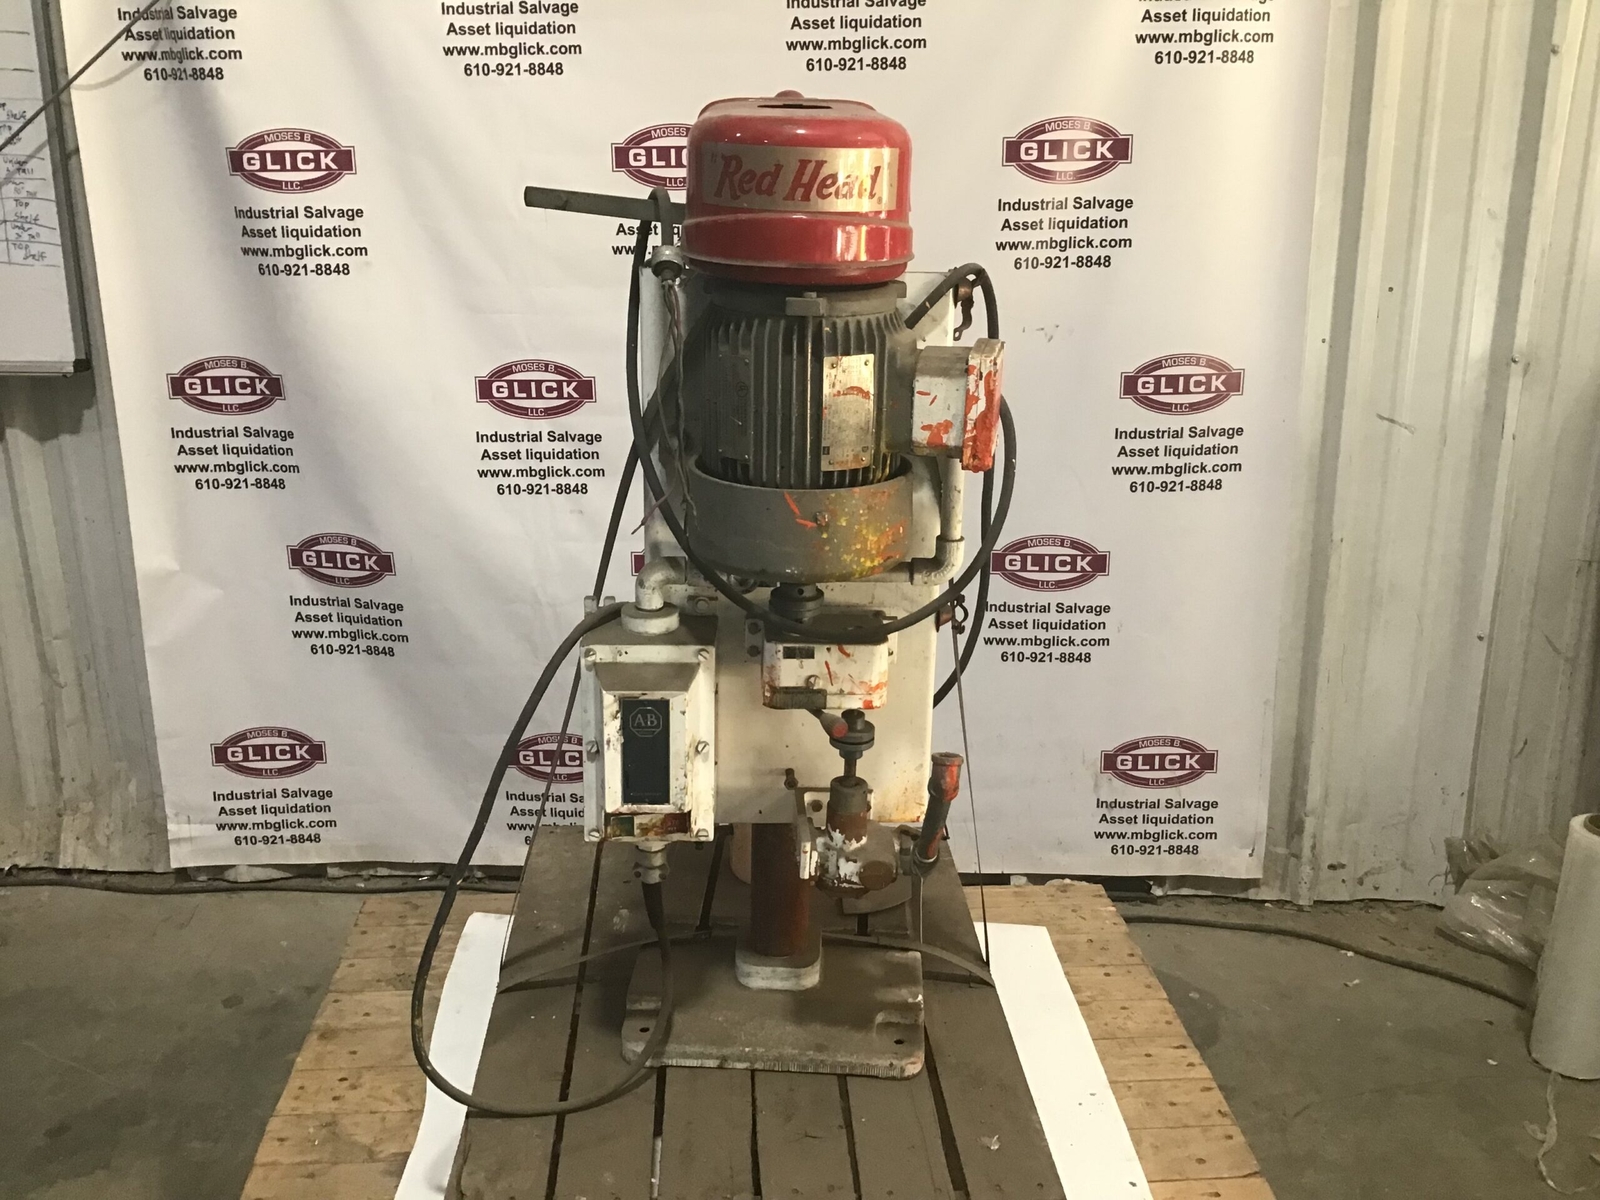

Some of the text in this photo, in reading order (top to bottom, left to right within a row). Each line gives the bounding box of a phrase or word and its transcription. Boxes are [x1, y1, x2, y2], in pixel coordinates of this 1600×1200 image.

[117, 6, 238, 22] Industrial Salvage
[441, 1, 579, 16] Industrial Salvage
[790, 14, 923, 32] Asset liquidation
[1141, 8, 1271, 25] Asset liquidation
[124, 27, 235, 43] Asset liquidation
[446, 21, 576, 39] Asset liquidation
[786, 36, 927, 53] www.mbglick.com
[1135, 29, 1274, 46] www.mbglick.com
[121, 47, 243, 64] www.mbglick.com
[442, 42, 582, 59] www.mbglick.com
[1154, 50, 1255, 65] 610-921-8848
[464, 63, 564, 77] 610-921-8848
[806, 56, 907, 72] 610-921-8848
[143, 67, 224, 81] 610-921-8848
[651, 127, 687, 139] MOSES
[1045, 120, 1081, 132] MOSES
[264, 132, 301, 143] MOSES
[1020, 140, 1115, 160] GLICK
[242, 151, 339, 171] GLICK
[628, 148, 688, 167] GLI
[783, 159, 882, 202] Head
[997, 196, 1134, 213] Industrial Salvage
[234, 206, 365, 222] Industrial Salvage
[615, 223, 659, 236] Ast
[1000, 216, 1128, 233] Asset liquidation
[241, 225, 362, 241] Asset liquidation
[995, 236, 1133, 252] www.mbglick.com
[240, 245, 368, 260] www.mbglick.com
[1013, 255, 1112, 270] 610-921-8848
[257, 263, 351, 277] 610-921-8848
[204, 360, 238, 370] MOSES
[512, 363, 545, 373] MOSES
[1162, 357, 1197, 368] MOSES
[184, 378, 271, 395] GLICK
[491, 382, 580, 398] GLICK
[1137, 375, 1227, 394] GLICK
[171, 426, 294, 441] Industrial Salvage
[476, 431, 603, 445] Industrial Salvage
[1114, 426, 1244, 441] Industrial Salvage
[177, 444, 294, 457] Asset liquidation
[481, 449, 600, 462] Asset liquidation
[1117, 443, 1239, 459] Asset liquidation
[174, 461, 300, 475] www.mbglick.com
[477, 466, 605, 480] www.mbglick.com
[1111, 462, 1242, 478] www.mbglick.com
[195, 478, 286, 490] 610-921-8848
[497, 483, 589, 496] 610-921-8848
[1129, 479, 1223, 493] 610-921-8848
[319, 536, 349, 545] MOSES
[1027, 538, 1061, 547] MOSES
[302, 550, 380, 571] GLICK
[1004, 554, 1093, 572] GLICK
[289, 595, 404, 614] Industrial Salvage
[985, 601, 1111, 615] Industrial Salvage
[294, 612, 403, 628] Asset liquidation
[988, 618, 1107, 632] Asset liquidation
[291, 629, 409, 643] www.mbglick.com
[983, 636, 1110, 649] www.mbglick.com
[310, 644, 395, 658] 610-921-8848
[1000, 651, 1092, 663] 610-921-8848
[247, 729, 279, 739] MOSES
[538, 736, 568, 744] MOSS
[1138, 739, 1171, 748] MOSES
[226, 745, 311, 762] GLICK
[518, 751, 581, 766] GLC
[1116, 755, 1201, 770] GLICK
[213, 788, 333, 802] Industrial Salvage
[218, 803, 332, 817] Asset liquidation
[1096, 798, 1219, 811] Industrial Salvage
[550, 807, 585, 820] liquid
[1099, 814, 1214, 827] Asset liquidation
[216, 819, 337, 832] www.mbglick.com
[234, 833, 322, 846] 610-921-8848
[1094, 830, 1218, 843] www.mbglick.com
[1111, 845, 1199, 855] 610-921-8848
